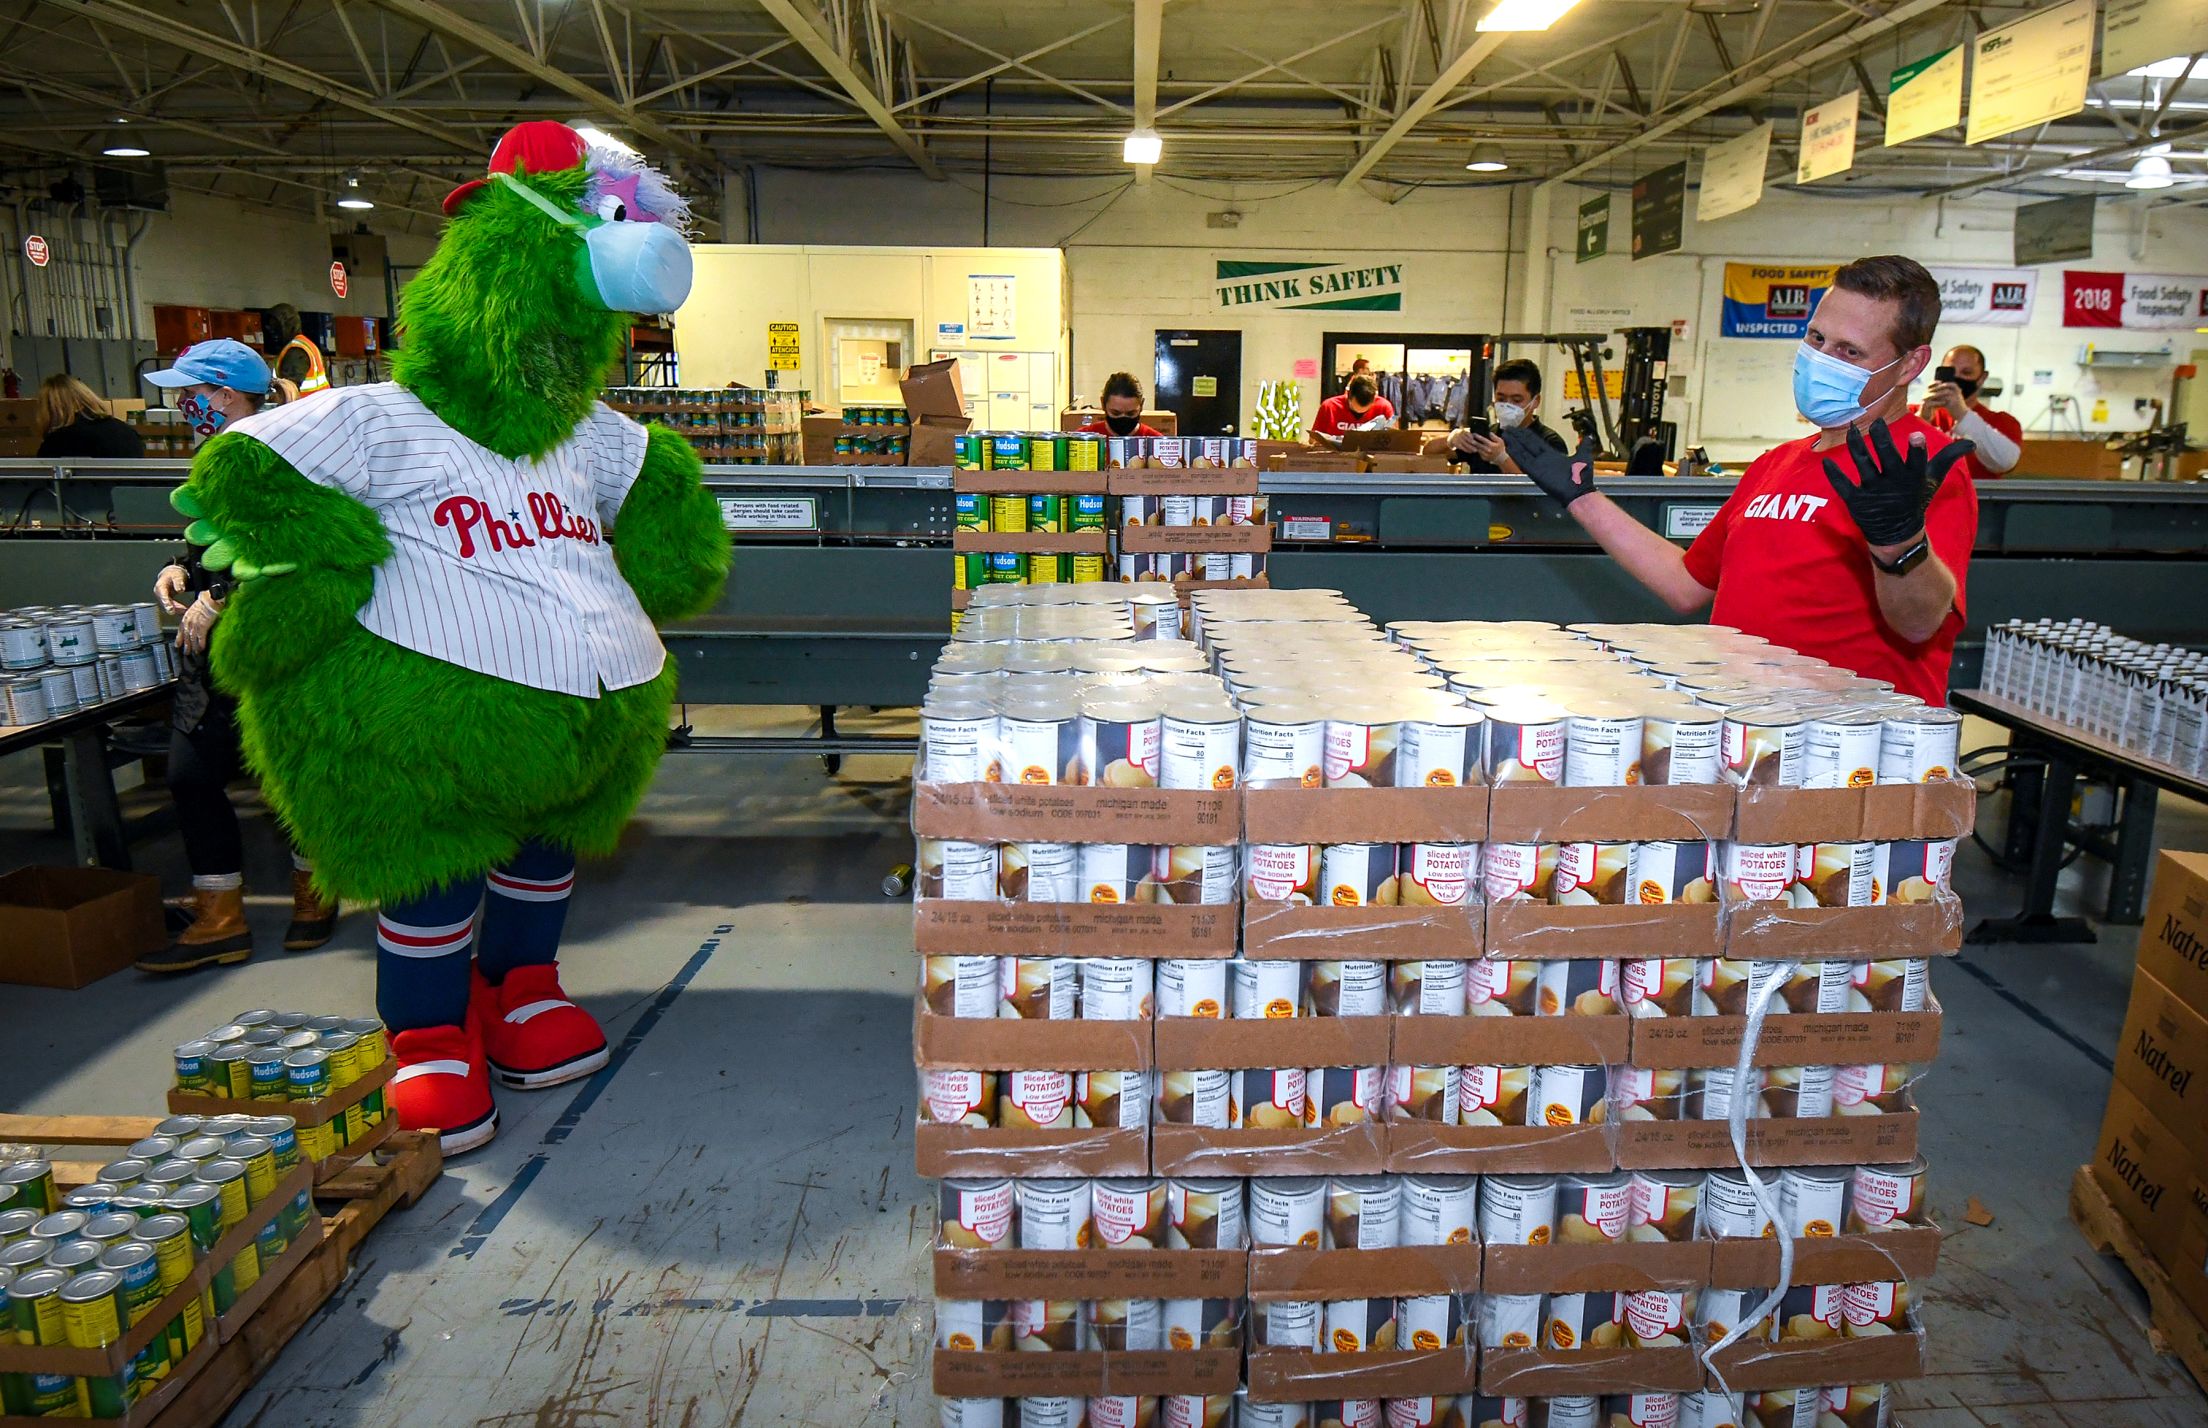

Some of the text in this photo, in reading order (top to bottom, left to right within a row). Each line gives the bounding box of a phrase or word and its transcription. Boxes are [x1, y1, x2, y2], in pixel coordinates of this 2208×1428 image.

[29, 241, 44, 251] STOP
[1752, 269, 1830, 279] FOOD SAFETY
[1216, 264, 1402, 307] THINK SAFETY
[1950, 280, 1983, 295] Safety
[1773, 288, 1805, 304] AIB
[2074, 287, 2112, 311] 2018
[2132, 286, 2193, 305] Food Safety
[1940, 296, 1975, 311] pected
[2136, 303, 2185, 317] Inspected
[1736, 322, 1798, 334] INSPECTED
[1650, 380, 1662, 418] TOYOTA
[1337, 421, 1361, 431] GIA
[996, 441, 1019, 450] Hudson
[1080, 499, 1103, 508] Hudson
[1744, 493, 1828, 522] GIANT
[434, 492, 599, 558] Phillies
[929, 725, 956, 733] Nutrition
[1249, 726, 1294, 738] Nutrition Facts
[1572, 723, 1599, 733] Nutrition
[1676, 729, 1707, 737] Nutrition
[1536, 729, 1556, 738] sliced
[1285, 751, 1294, 759] 80
[1096, 798, 1167, 810] michigan made
[1008, 808, 1044, 818] sodium
[1427, 850, 1451, 859] sliced
[1740, 850, 1787, 859] sliced white
[1253, 857, 1295, 869] POTATOES
[1426, 858, 1470, 869] POTATOES
[1740, 859, 1786, 869] POTATOES
[958, 960, 986, 968] Nutrition
[1344, 963, 1371, 971] Nutrition
[1425, 962, 1452, 970] Nutrition
[1649, 1028, 1688, 1038] 24/15 oz
[1803, 1022, 1869, 1034] michigan made
[2133, 1028, 2195, 1100] Natrel
[253, 1064, 284, 1076] Hudson
[290, 1067, 320, 1079] Hudson
[948, 1074, 969, 1082] white
[1023, 1074, 1046, 1082] sliced
[1023, 1080, 1065, 1092] POTATOES
[2106, 1136, 2166, 1214] Natrel
[1710, 1179, 1735, 1193] Nutrition
[1875, 1179, 1898, 1189] white
[974, 1194, 995, 1203] sliced
[1051, 1196, 1070, 1204] Facts
[1422, 1193, 1440, 1202] Facts
[1503, 1191, 1522, 1201] Facts
[1600, 1190, 1622, 1200] sliced
[1114, 1196, 1134, 1205] white
[1270, 1198, 1289, 1207] Facts
[1363, 1196, 1389, 1206] Nutrition
[1512, 1212, 1521, 1220] 80
[1747, 1208, 1756, 1216] 80
[1280, 1218, 1289, 1226] 80
[1647, 1293, 1669, 1304] white
[1640, 1307, 1665, 1320] SODIUM
[1645, 1395, 1666, 1405] sliced
